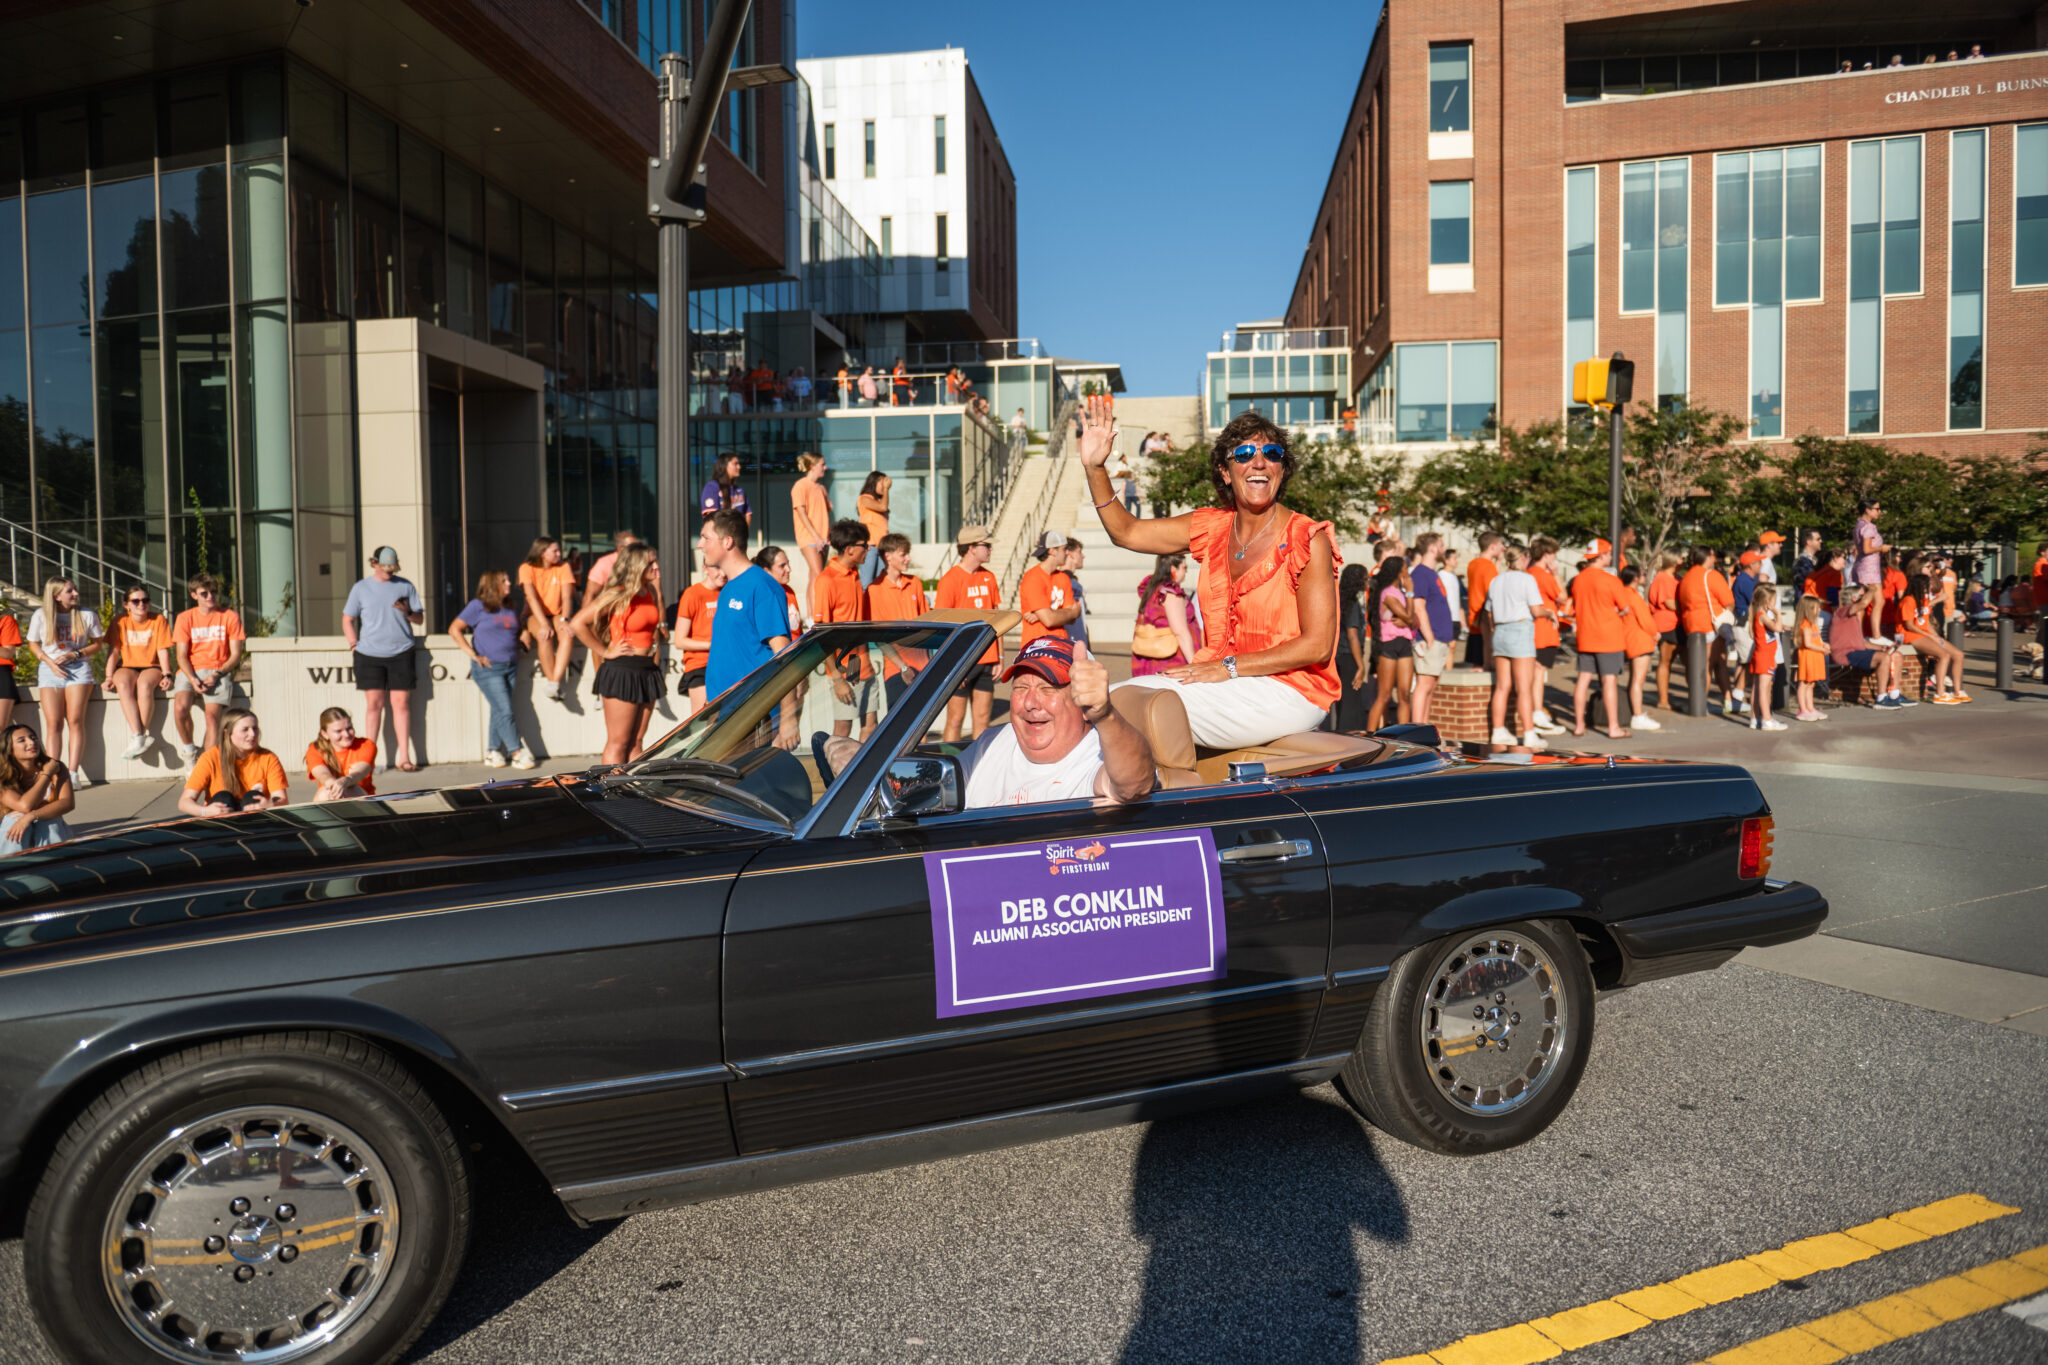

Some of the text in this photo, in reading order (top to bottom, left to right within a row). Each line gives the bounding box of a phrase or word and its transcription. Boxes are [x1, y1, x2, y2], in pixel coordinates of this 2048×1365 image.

[1885, 84, 1971, 104] CHANDLER
[1977, 83, 1991, 95] L.
[430, 664, 456, 682] O.
[1046, 846, 1075, 864] Spirit
[1061, 861, 1110, 875] FIRST FRIDAY
[1001, 884, 1164, 925] DEB CONKLIN
[972, 906, 1193, 946] ALUMNI ASSOCIATON PRESIDENT
